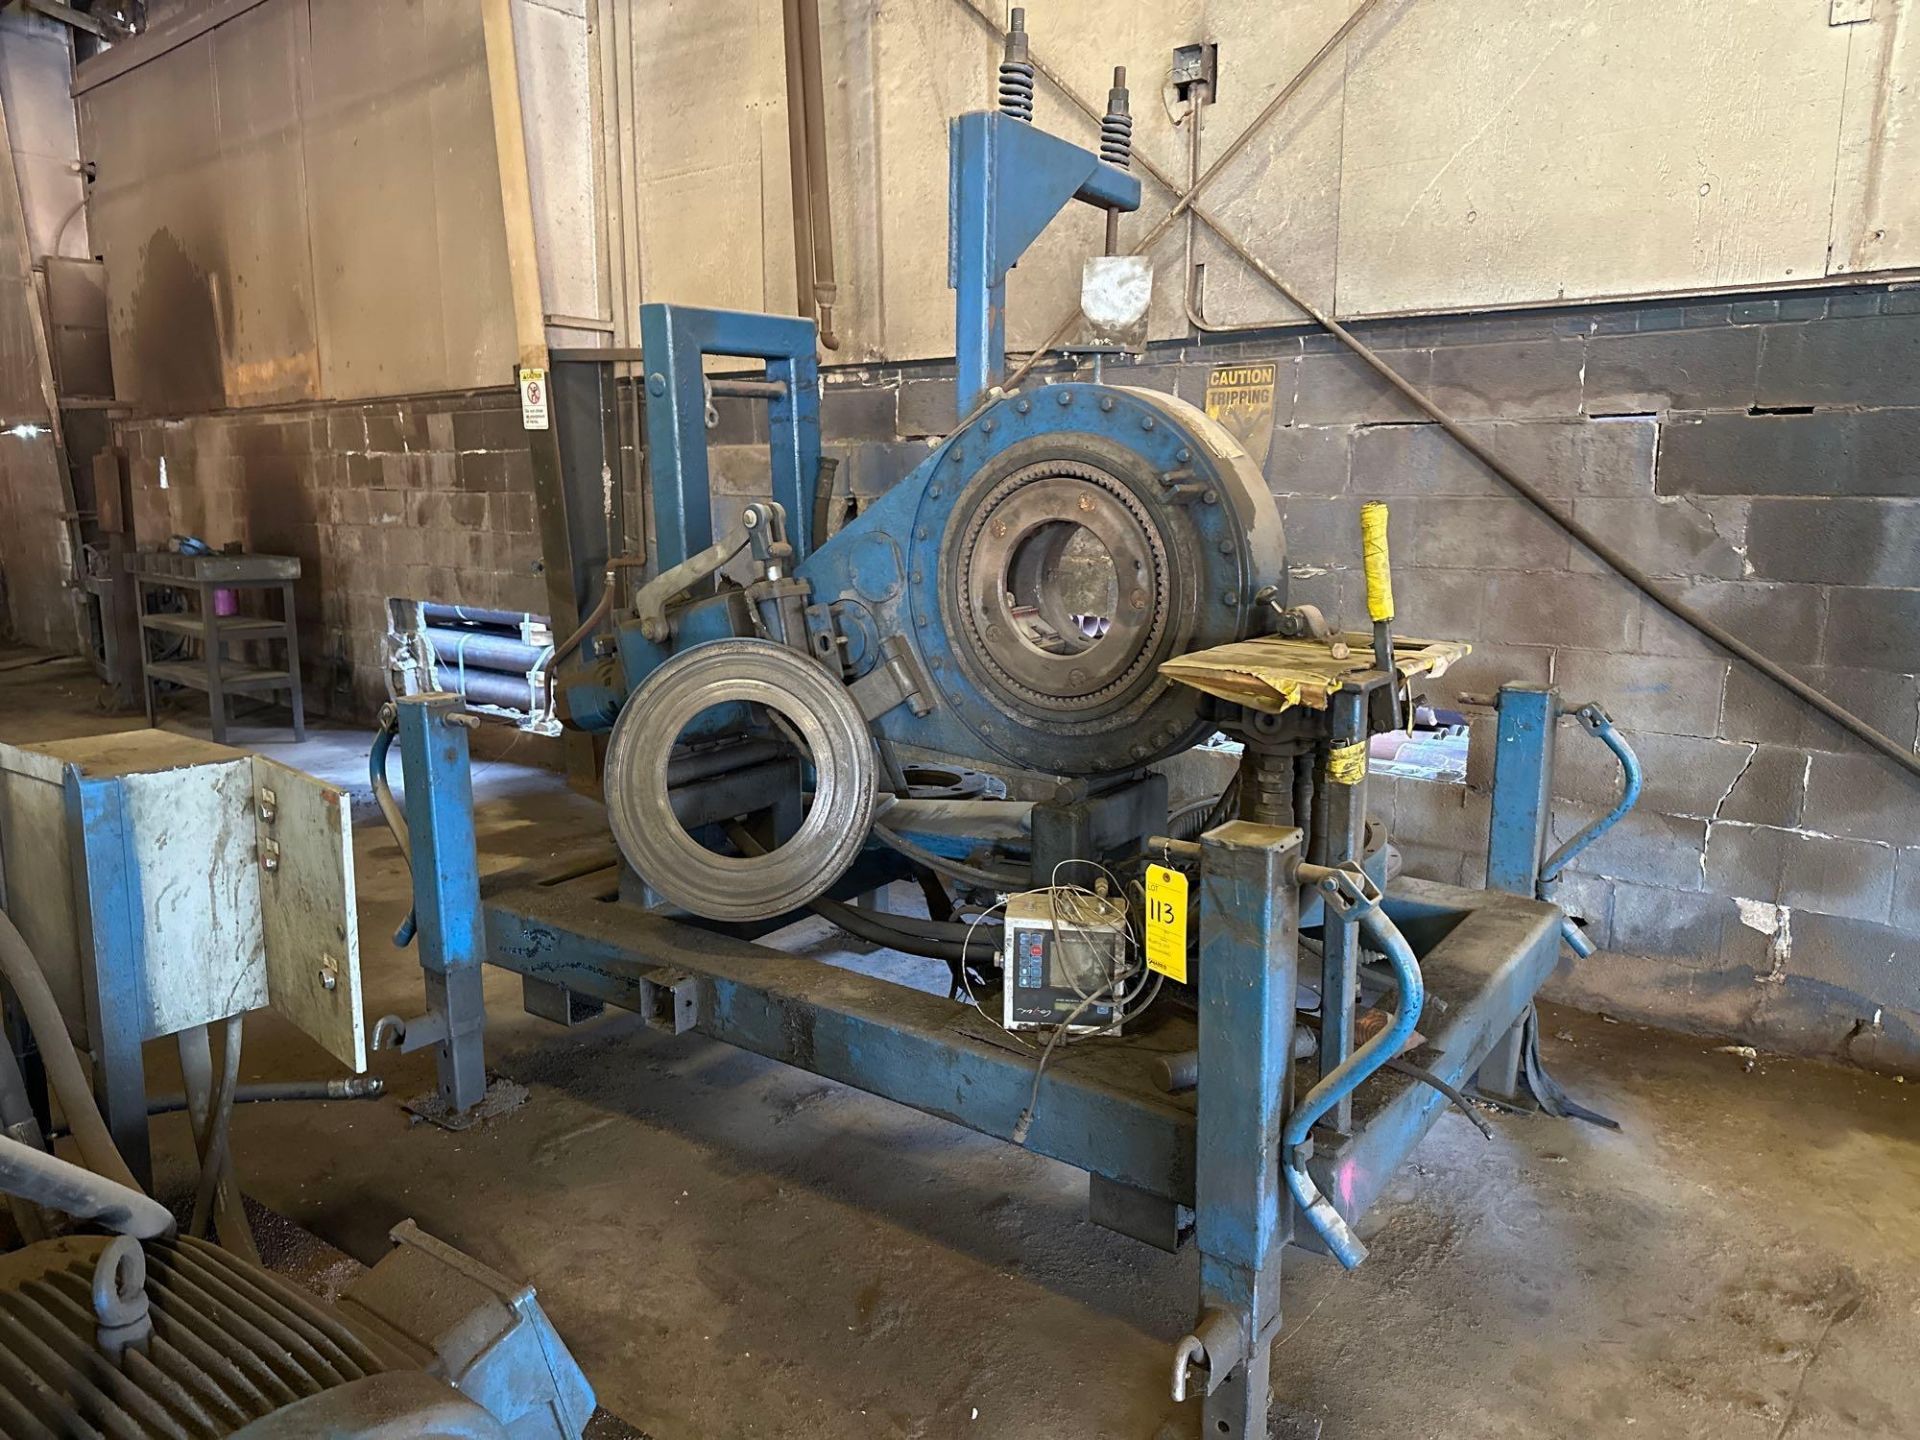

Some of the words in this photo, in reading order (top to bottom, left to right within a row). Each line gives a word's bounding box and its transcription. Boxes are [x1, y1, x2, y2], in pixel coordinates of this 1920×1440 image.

[1210, 368, 1272, 386] CAUTION
[1210, 389, 1270, 405] TRIPPING
[1147, 884, 1159, 893] LOT
[1150, 897, 1175, 925] 113
